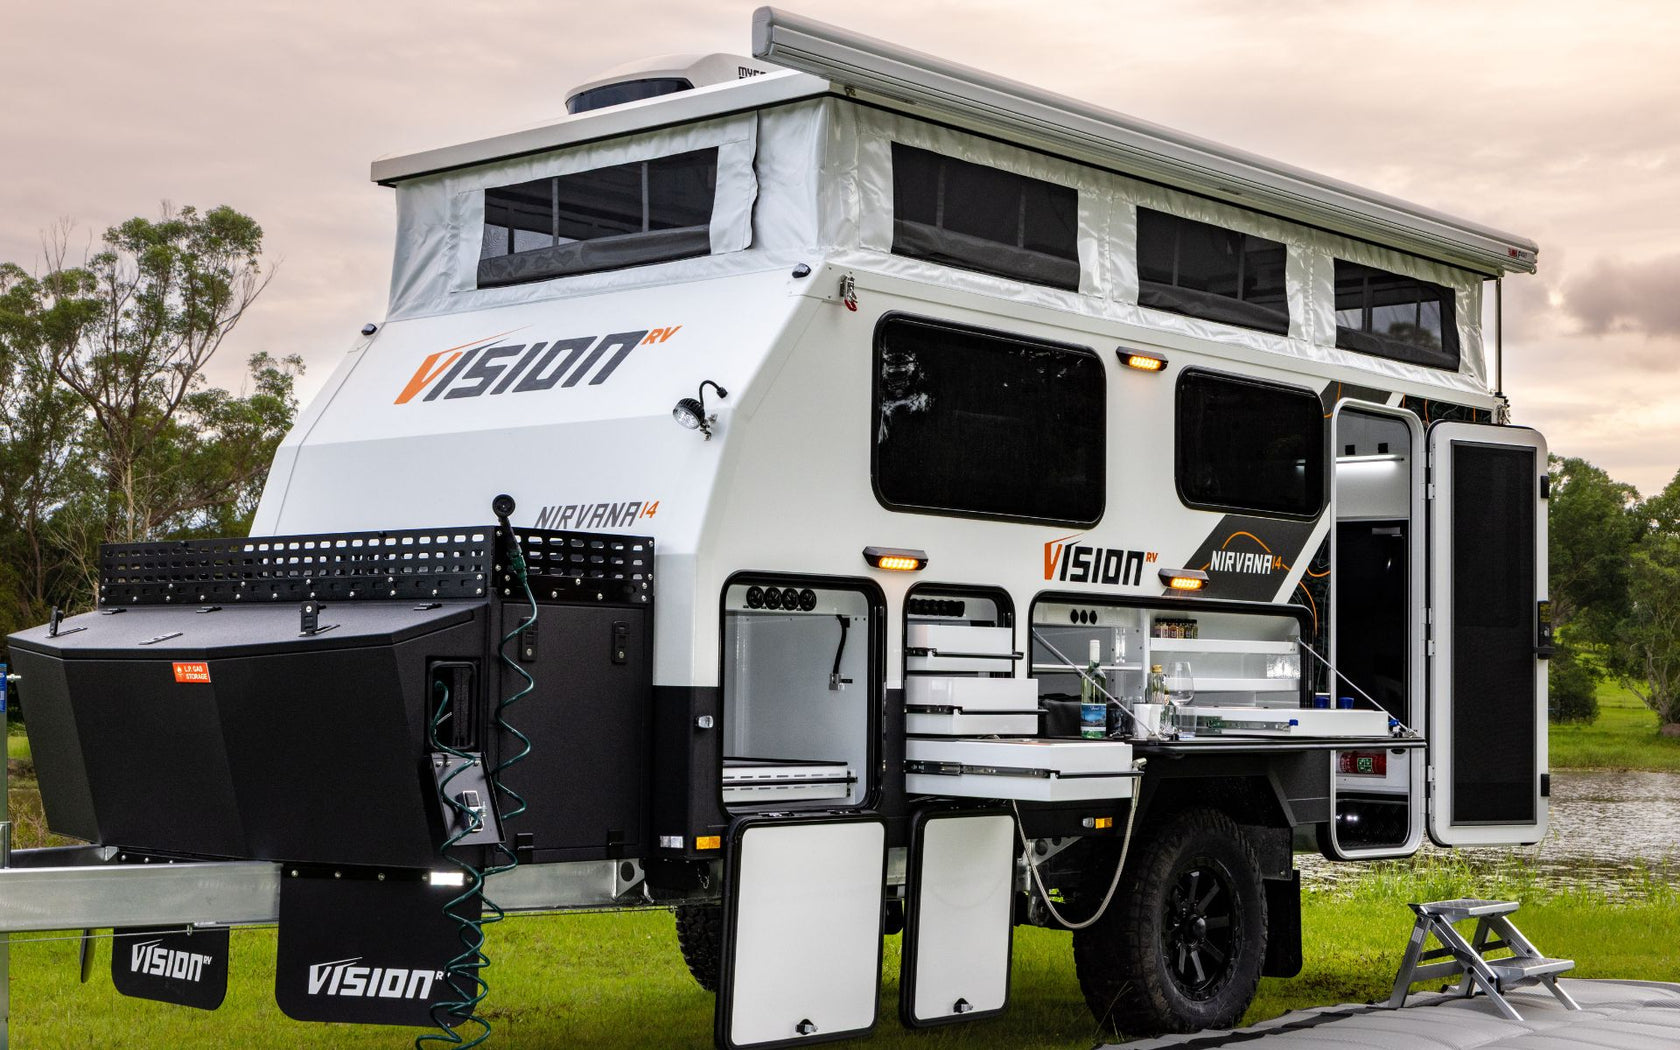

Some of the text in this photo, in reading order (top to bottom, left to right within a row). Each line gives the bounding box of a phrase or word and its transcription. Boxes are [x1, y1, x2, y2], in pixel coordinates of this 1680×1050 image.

[393, 325, 682, 405] VISION RV
[534, 501, 660, 529] NIRVANA 14
[1044, 534, 1158, 586] VISION RV
[1210, 550, 1282, 574] NIRVANA 14
[131, 942, 212, 982] VISION RV
[308, 960, 435, 999] VISION
